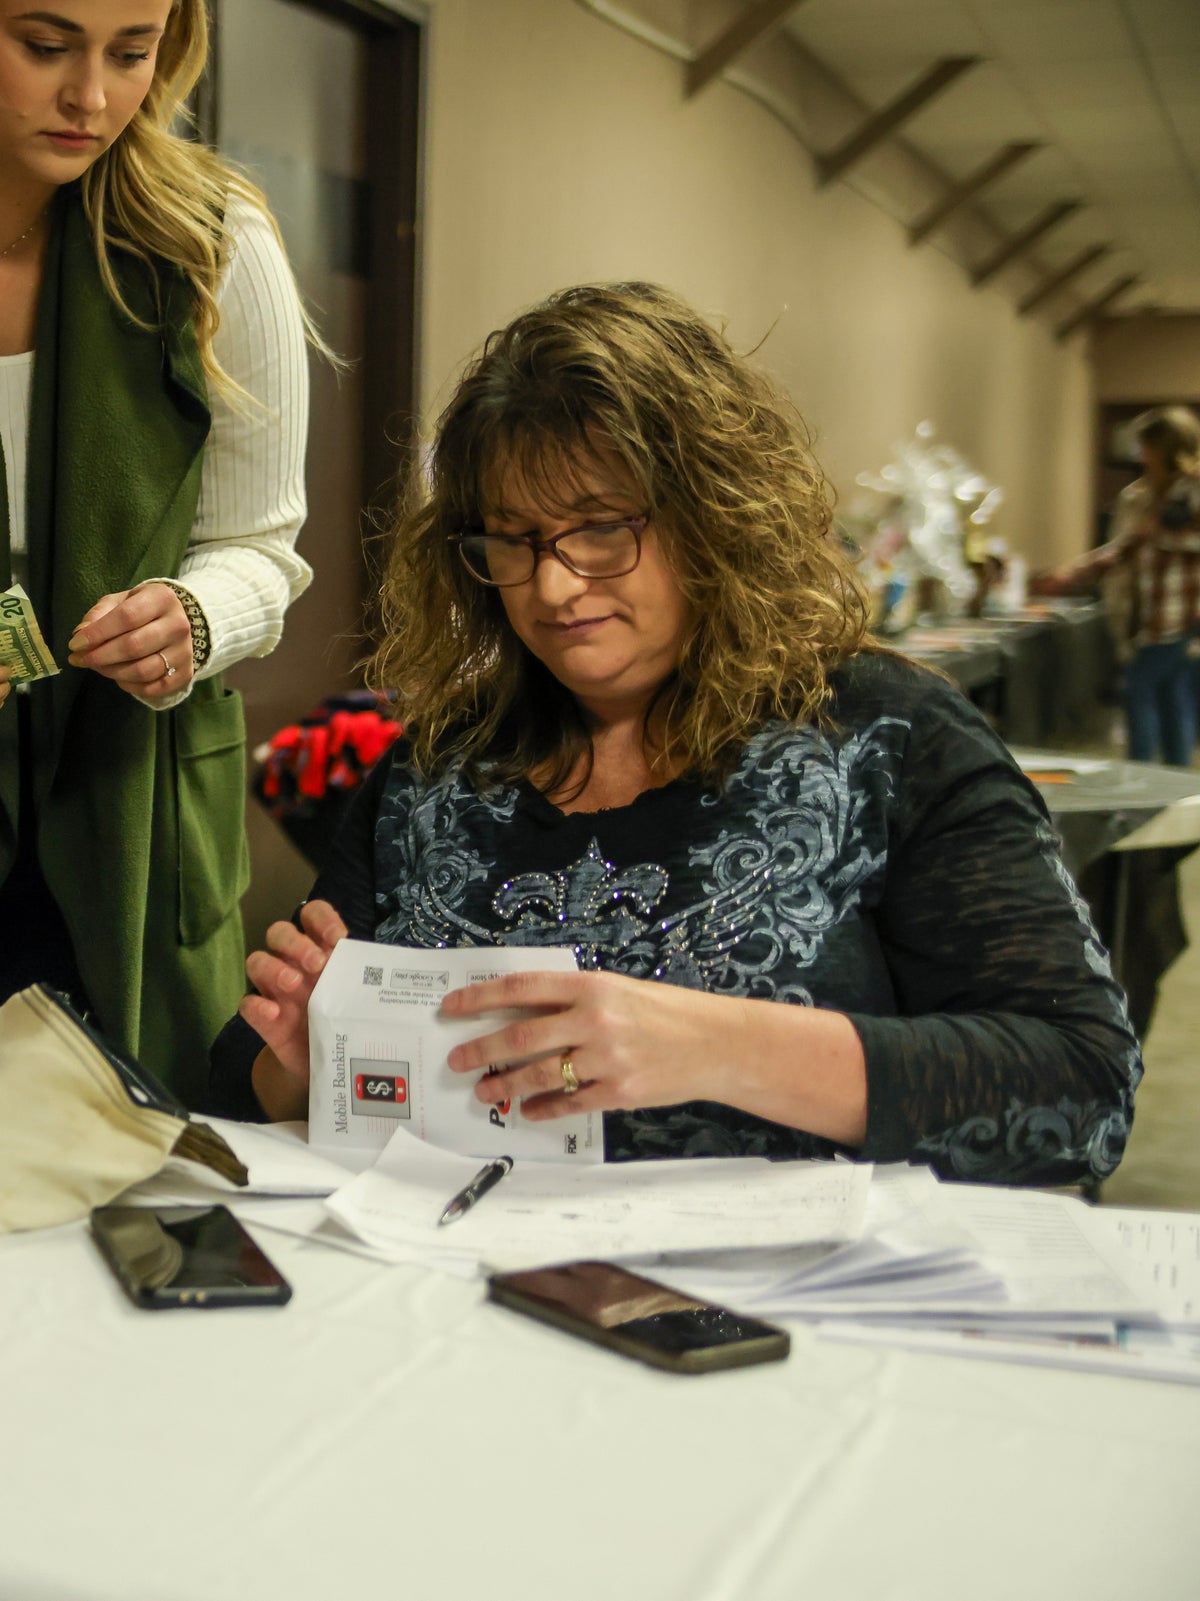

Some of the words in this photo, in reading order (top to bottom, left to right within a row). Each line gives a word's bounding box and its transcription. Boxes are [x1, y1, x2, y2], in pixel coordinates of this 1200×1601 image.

[0, 597, 24, 618] 20
[332, 1033, 348, 1089] Banking
[334, 1091, 349, 1135] Mobile
[567, 1133, 577, 1155] FDIC
